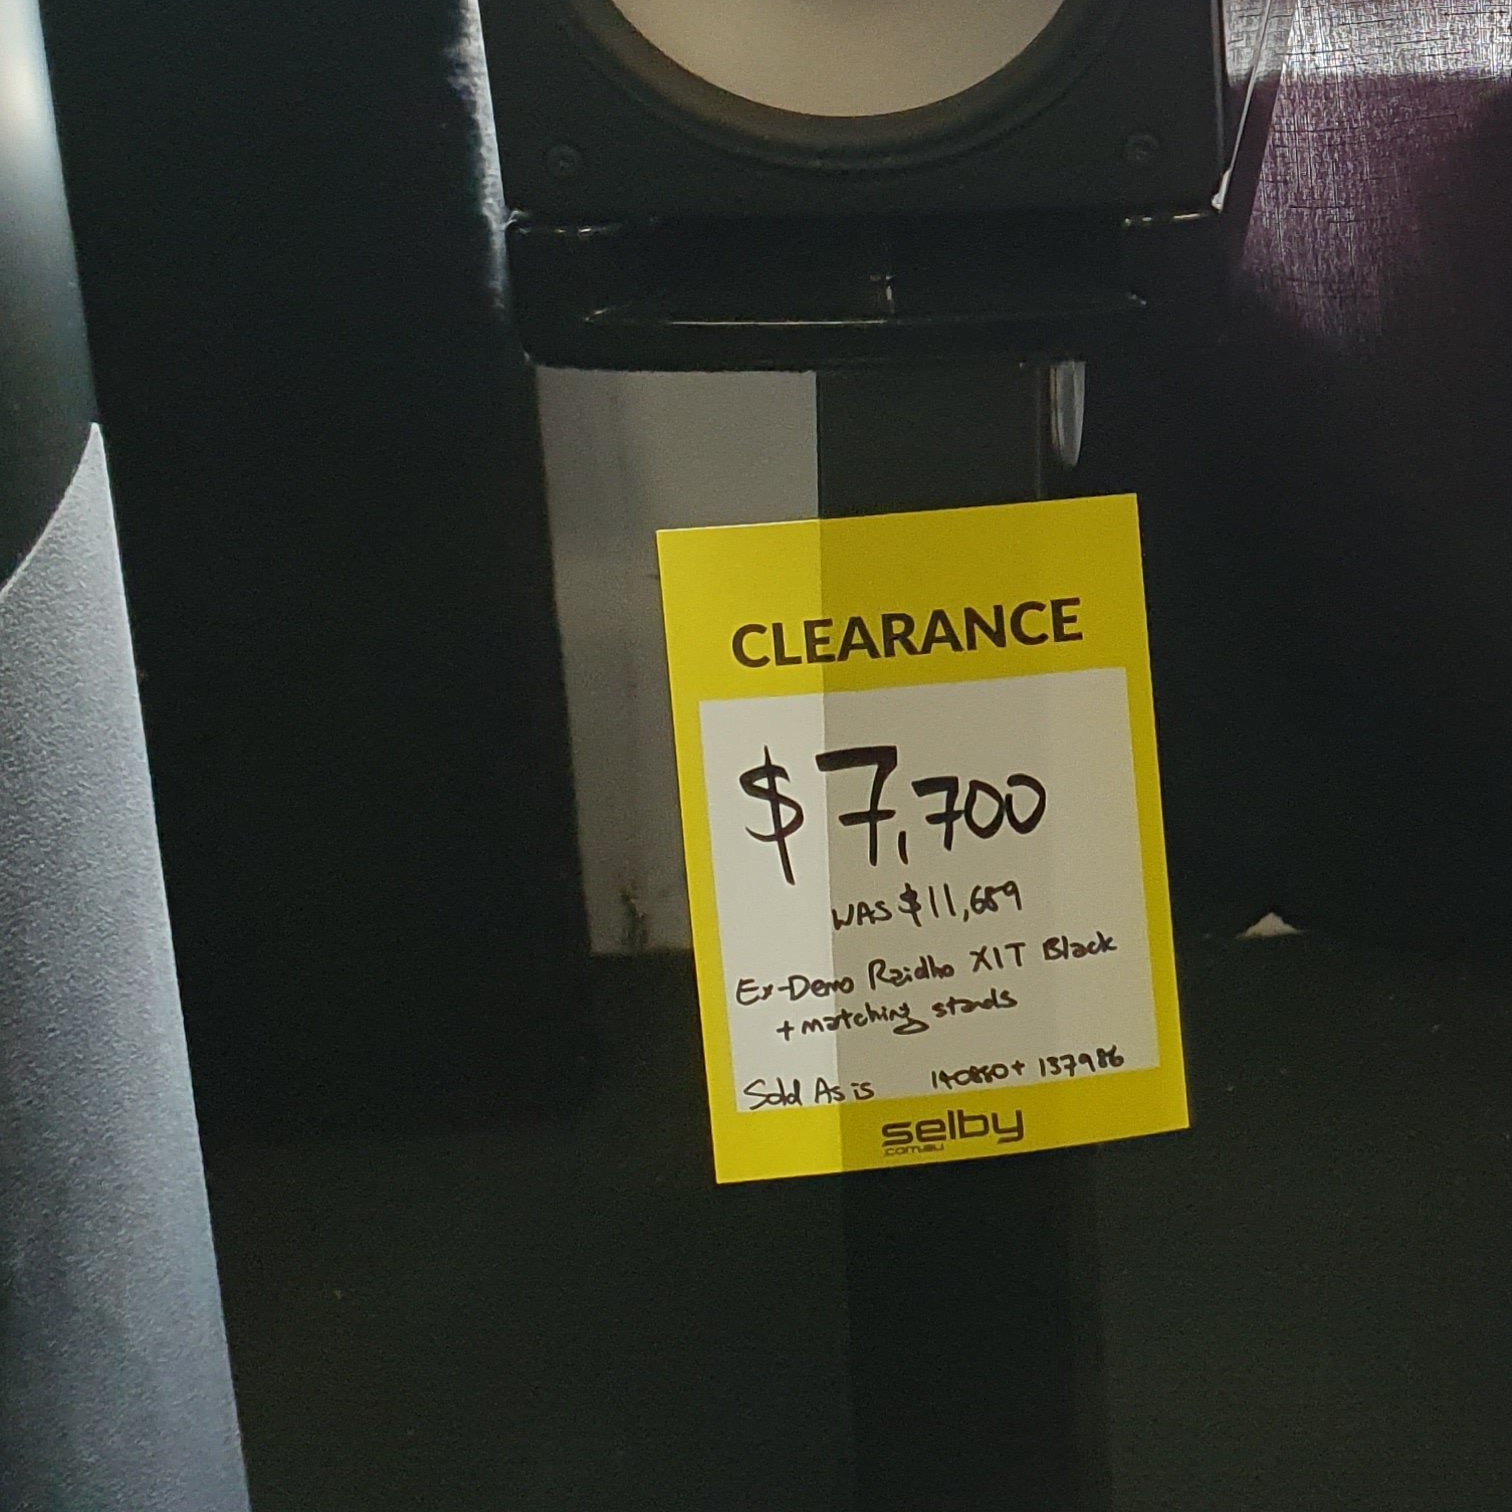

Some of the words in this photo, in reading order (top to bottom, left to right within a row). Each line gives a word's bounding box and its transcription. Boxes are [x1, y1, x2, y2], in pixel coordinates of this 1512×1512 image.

[731, 597, 1084, 668] CLEARANCE
[832, 900, 892, 930] WAS
[736, 975, 854, 1005] Ex-Demo
[1042, 931, 1117, 961] Black
[931, 988, 1018, 1018] stands
[743, 1077, 802, 1110] Sold
[814, 1077, 845, 1104] As
[849, 1081, 875, 1101] is
[881, 1109, 1024, 1148] selby
